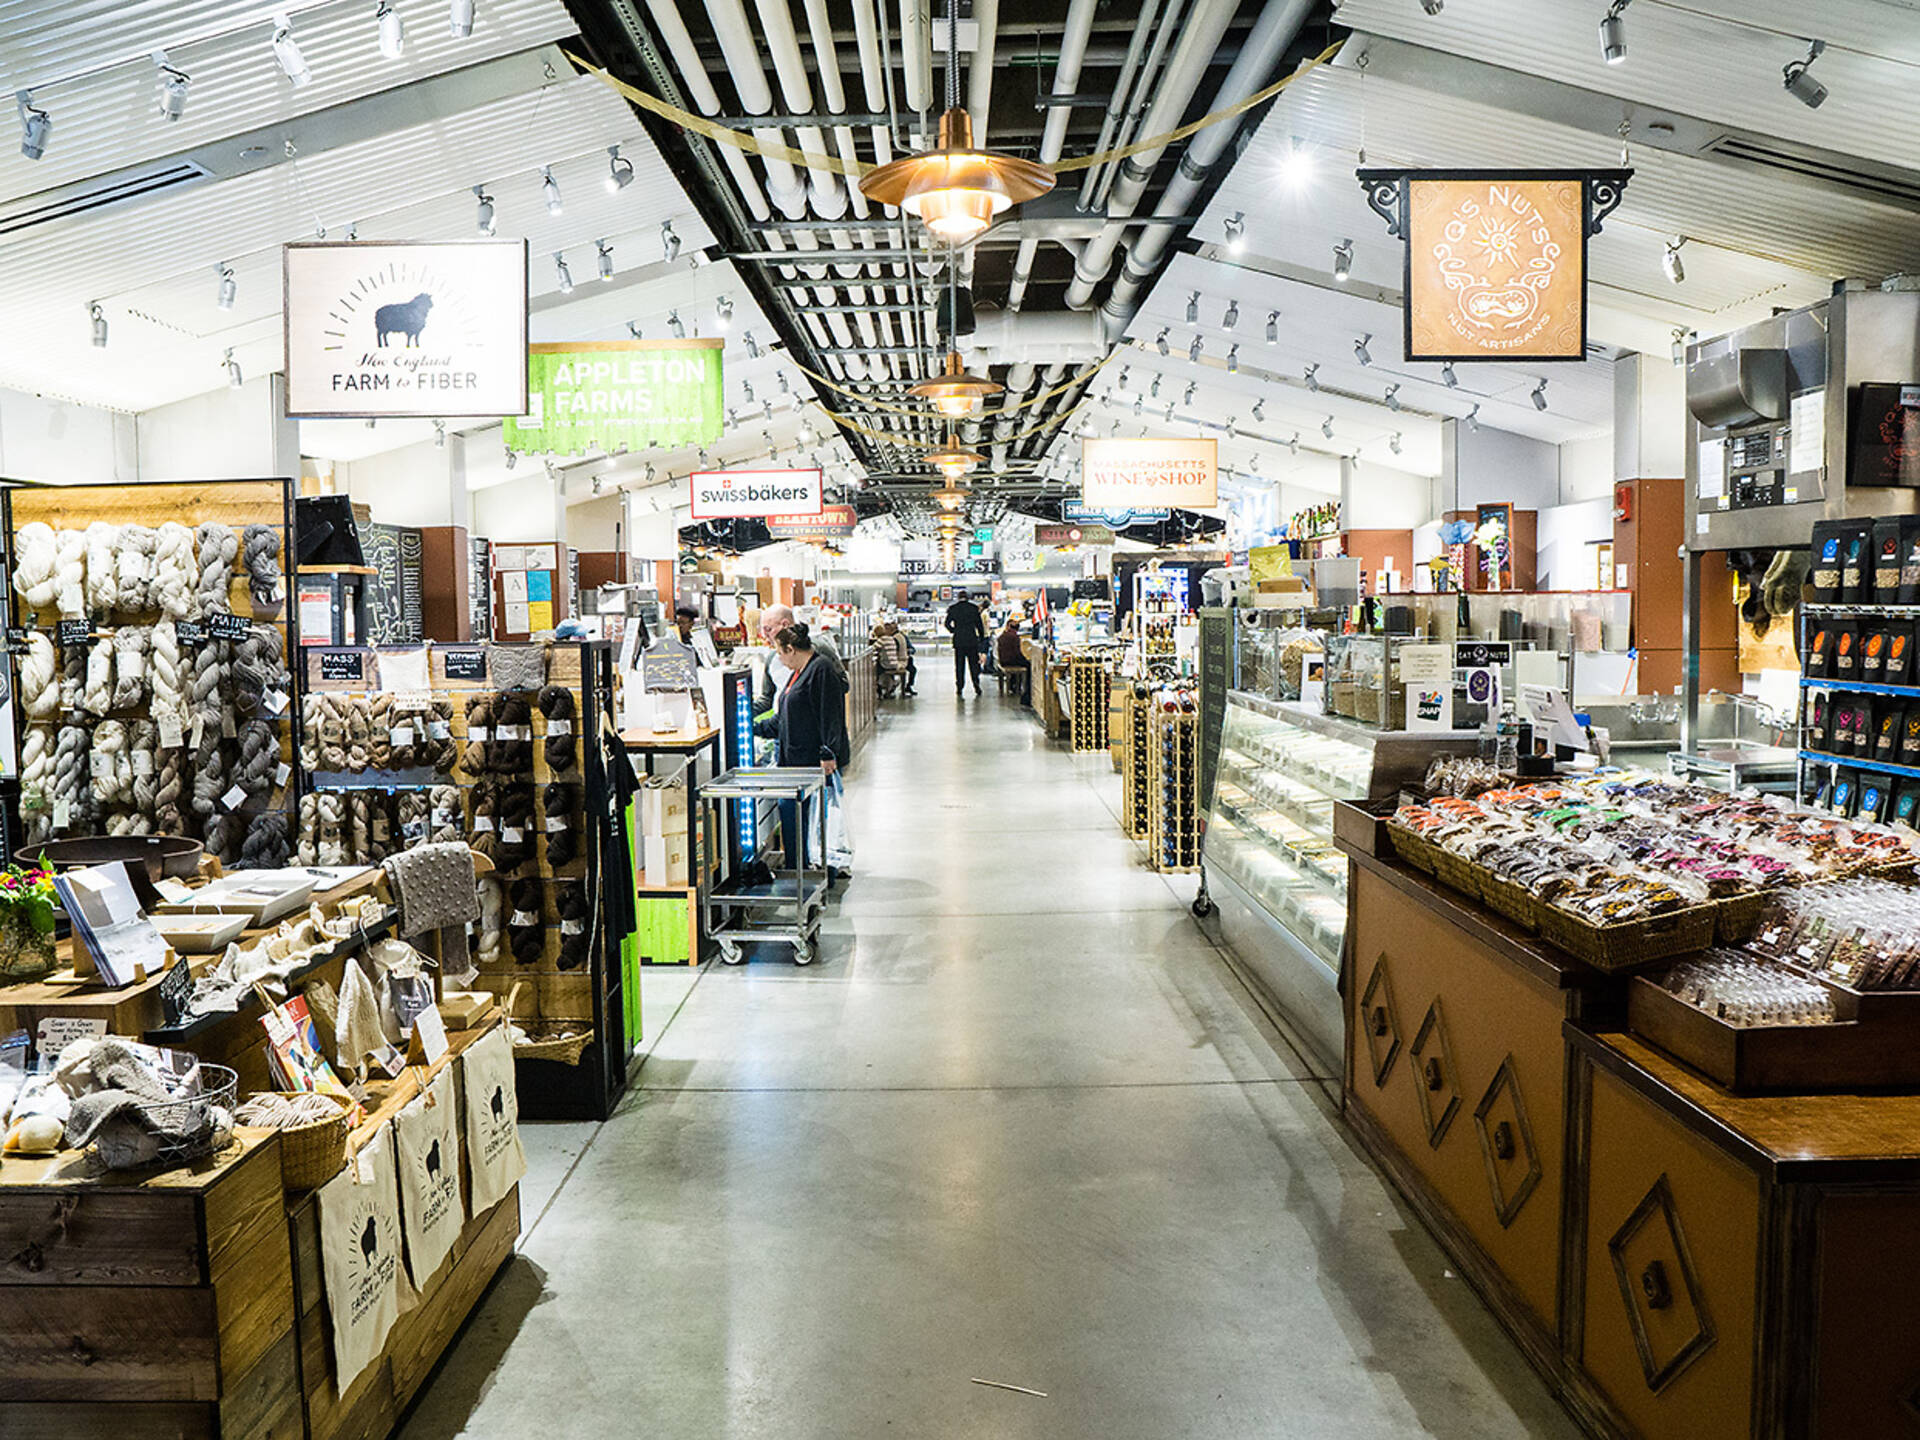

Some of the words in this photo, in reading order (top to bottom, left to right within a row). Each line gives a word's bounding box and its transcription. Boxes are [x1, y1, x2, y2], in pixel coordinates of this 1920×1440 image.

[1489, 186, 1550, 245] NUTS
[1448, 312, 1476, 341] NUT
[1478, 313, 1551, 350] ARTISANS
[393, 354, 452, 373] England
[553, 358, 706, 387] APPLETON
[332, 373, 390, 391] FARM
[417, 371, 478, 390] FIBER
[555, 388, 651, 414] FARMS
[1093, 459, 1207, 470] MASSACHUSETTS
[1094, 471, 1144, 485] WINE
[1159, 471, 1207, 486] SHOP
[701, 484, 809, 504] swissbäkers
